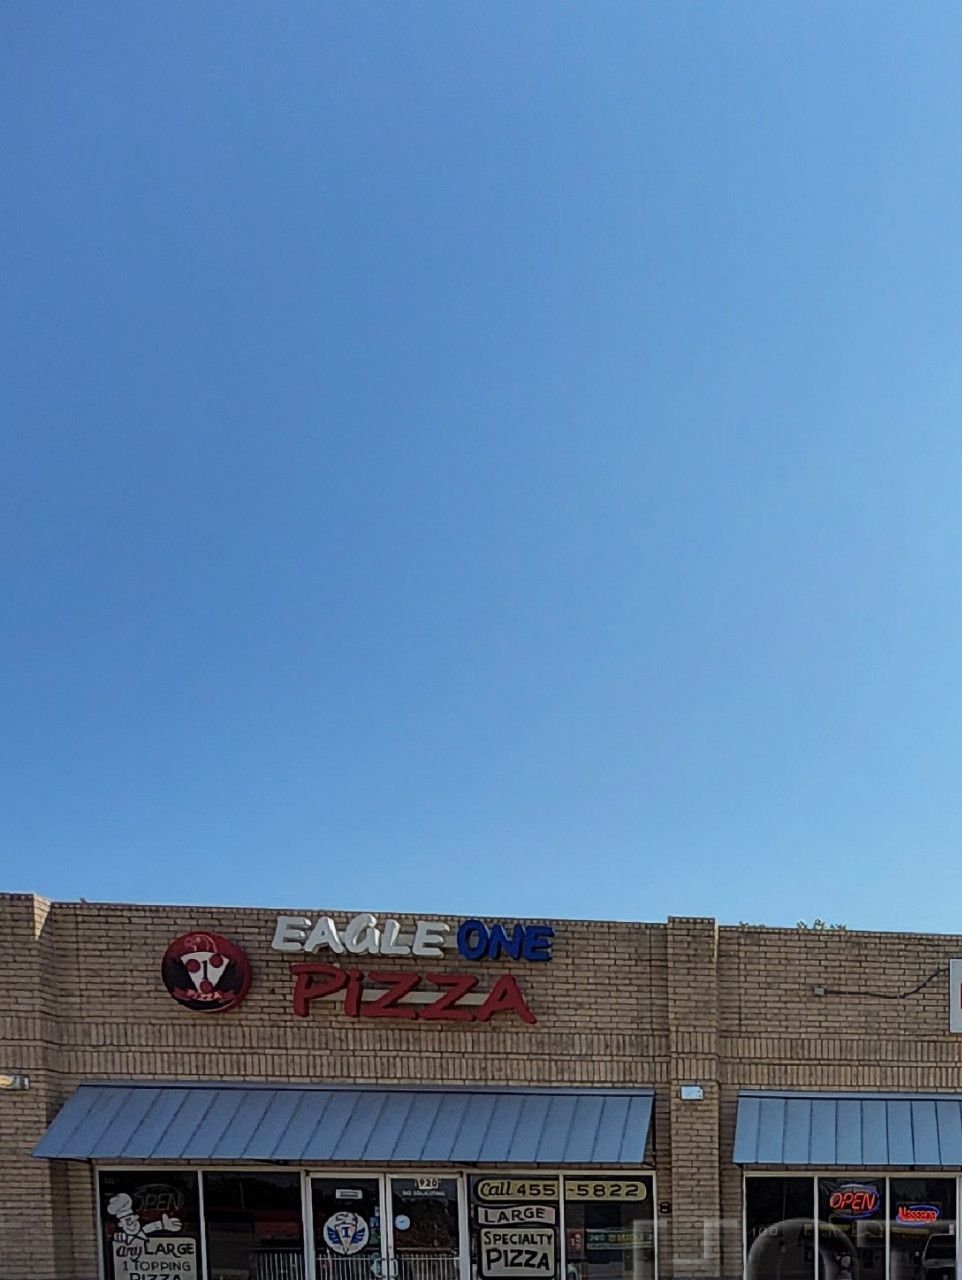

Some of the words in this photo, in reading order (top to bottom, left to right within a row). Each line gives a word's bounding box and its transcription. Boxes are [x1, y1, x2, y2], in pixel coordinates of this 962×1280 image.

[271, 913, 450, 959] EAGLE
[457, 919, 555, 962] ONE
[289, 963, 537, 1024] PIZZA
[480, 1181, 512, 1197] Call
[830, 1191, 875, 1211] OPEN
[484, 1207, 546, 1224] LARGE
[483, 1230, 552, 1246] SPECIALTY
[144, 1243, 194, 1259] LARGE
[486, 1248, 551, 1271] PIZZA
[134, 1260, 191, 1272] TOPPING
